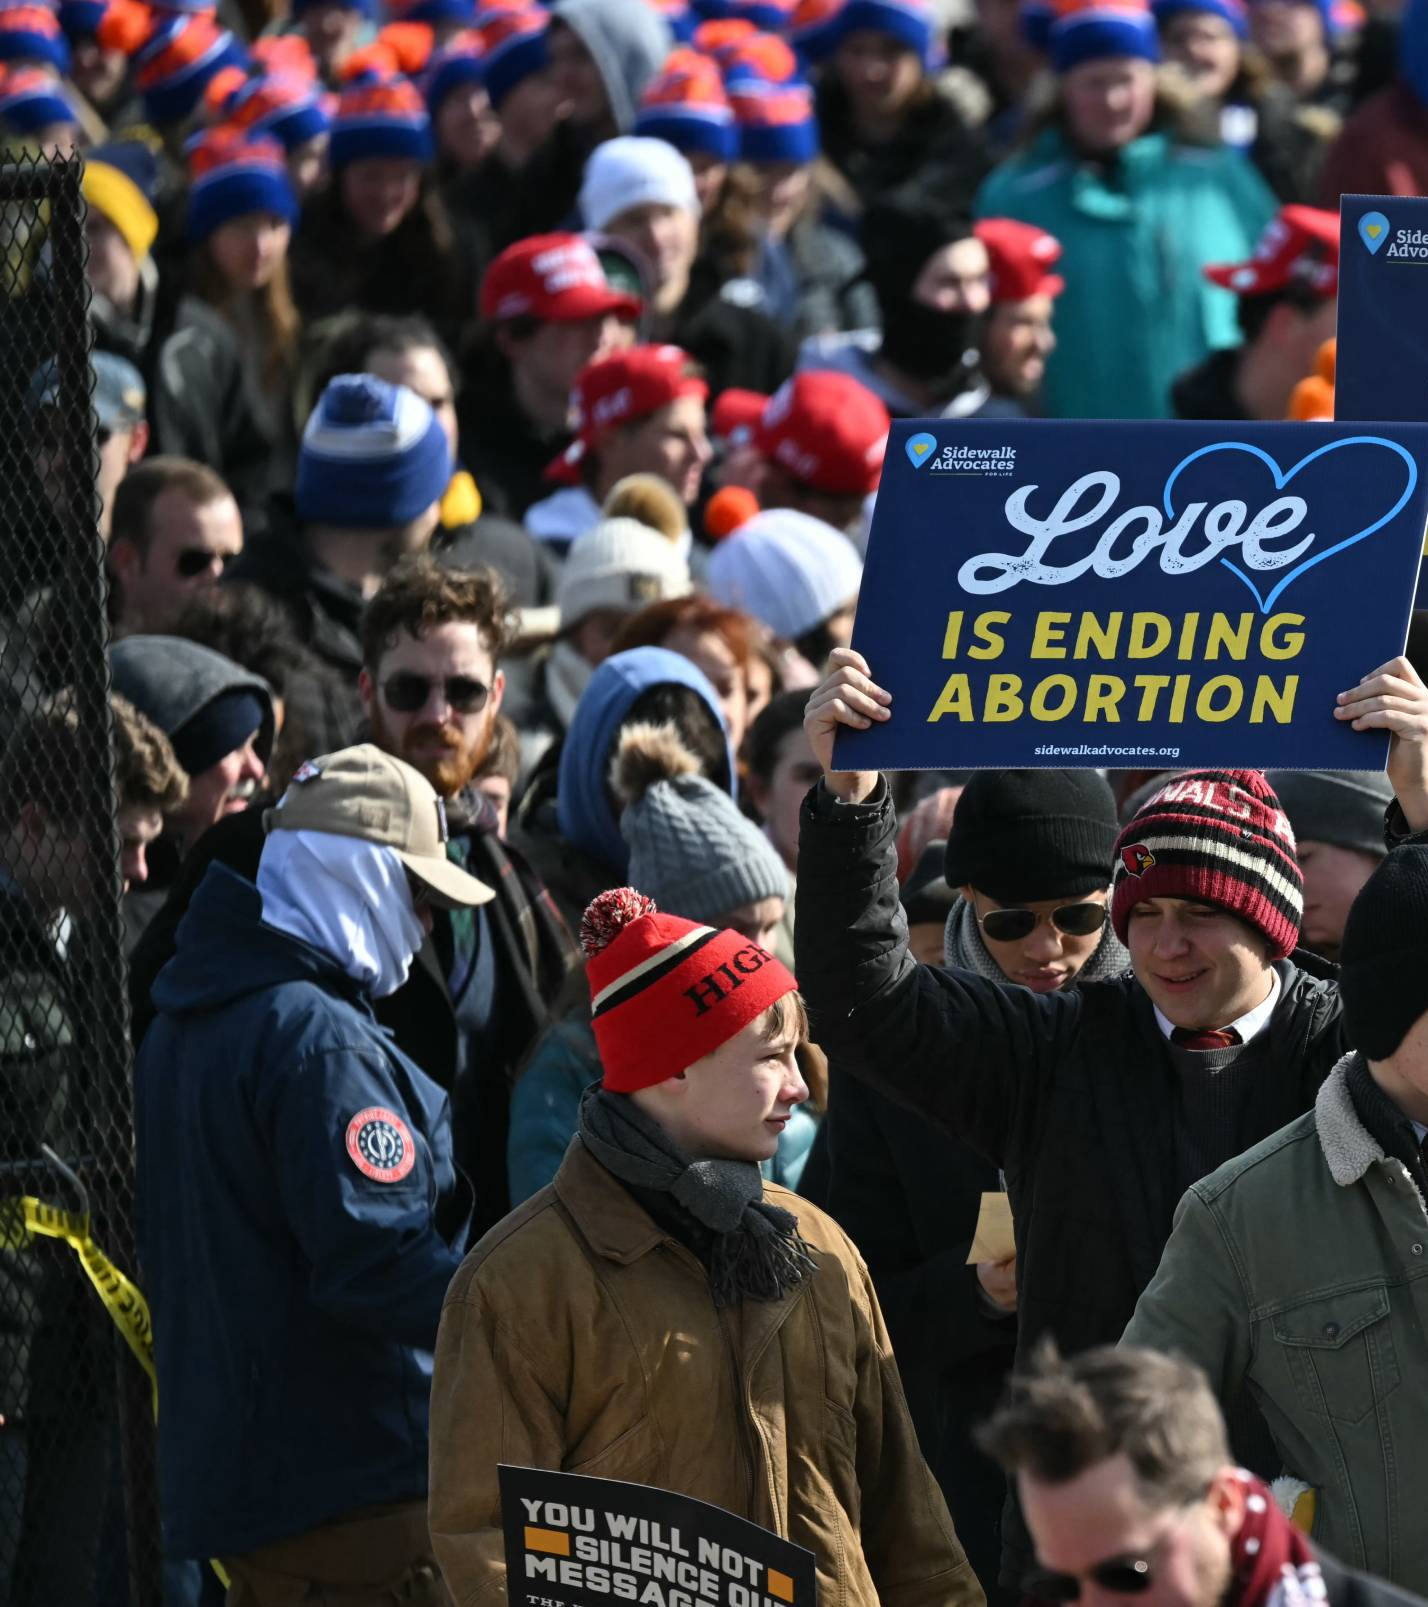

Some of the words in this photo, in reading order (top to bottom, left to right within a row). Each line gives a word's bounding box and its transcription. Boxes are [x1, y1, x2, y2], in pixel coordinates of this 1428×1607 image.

[930, 457, 1015, 470] Advocates
[942, 446, 1017, 459] Sidewalk
[956, 470, 1316, 596] Love
[942, 610, 1012, 660] IS
[1030, 611, 1305, 660] ENDING
[926, 673, 1299, 724] ABORTION
[1034, 744, 1181, 758] sidewalkadvocates.org
[519, 1497, 596, 1532] YOU
[603, 1511, 690, 1558] WILL
[697, 1536, 764, 1588] NOT
[574, 1534, 720, 1601] SILENCE
